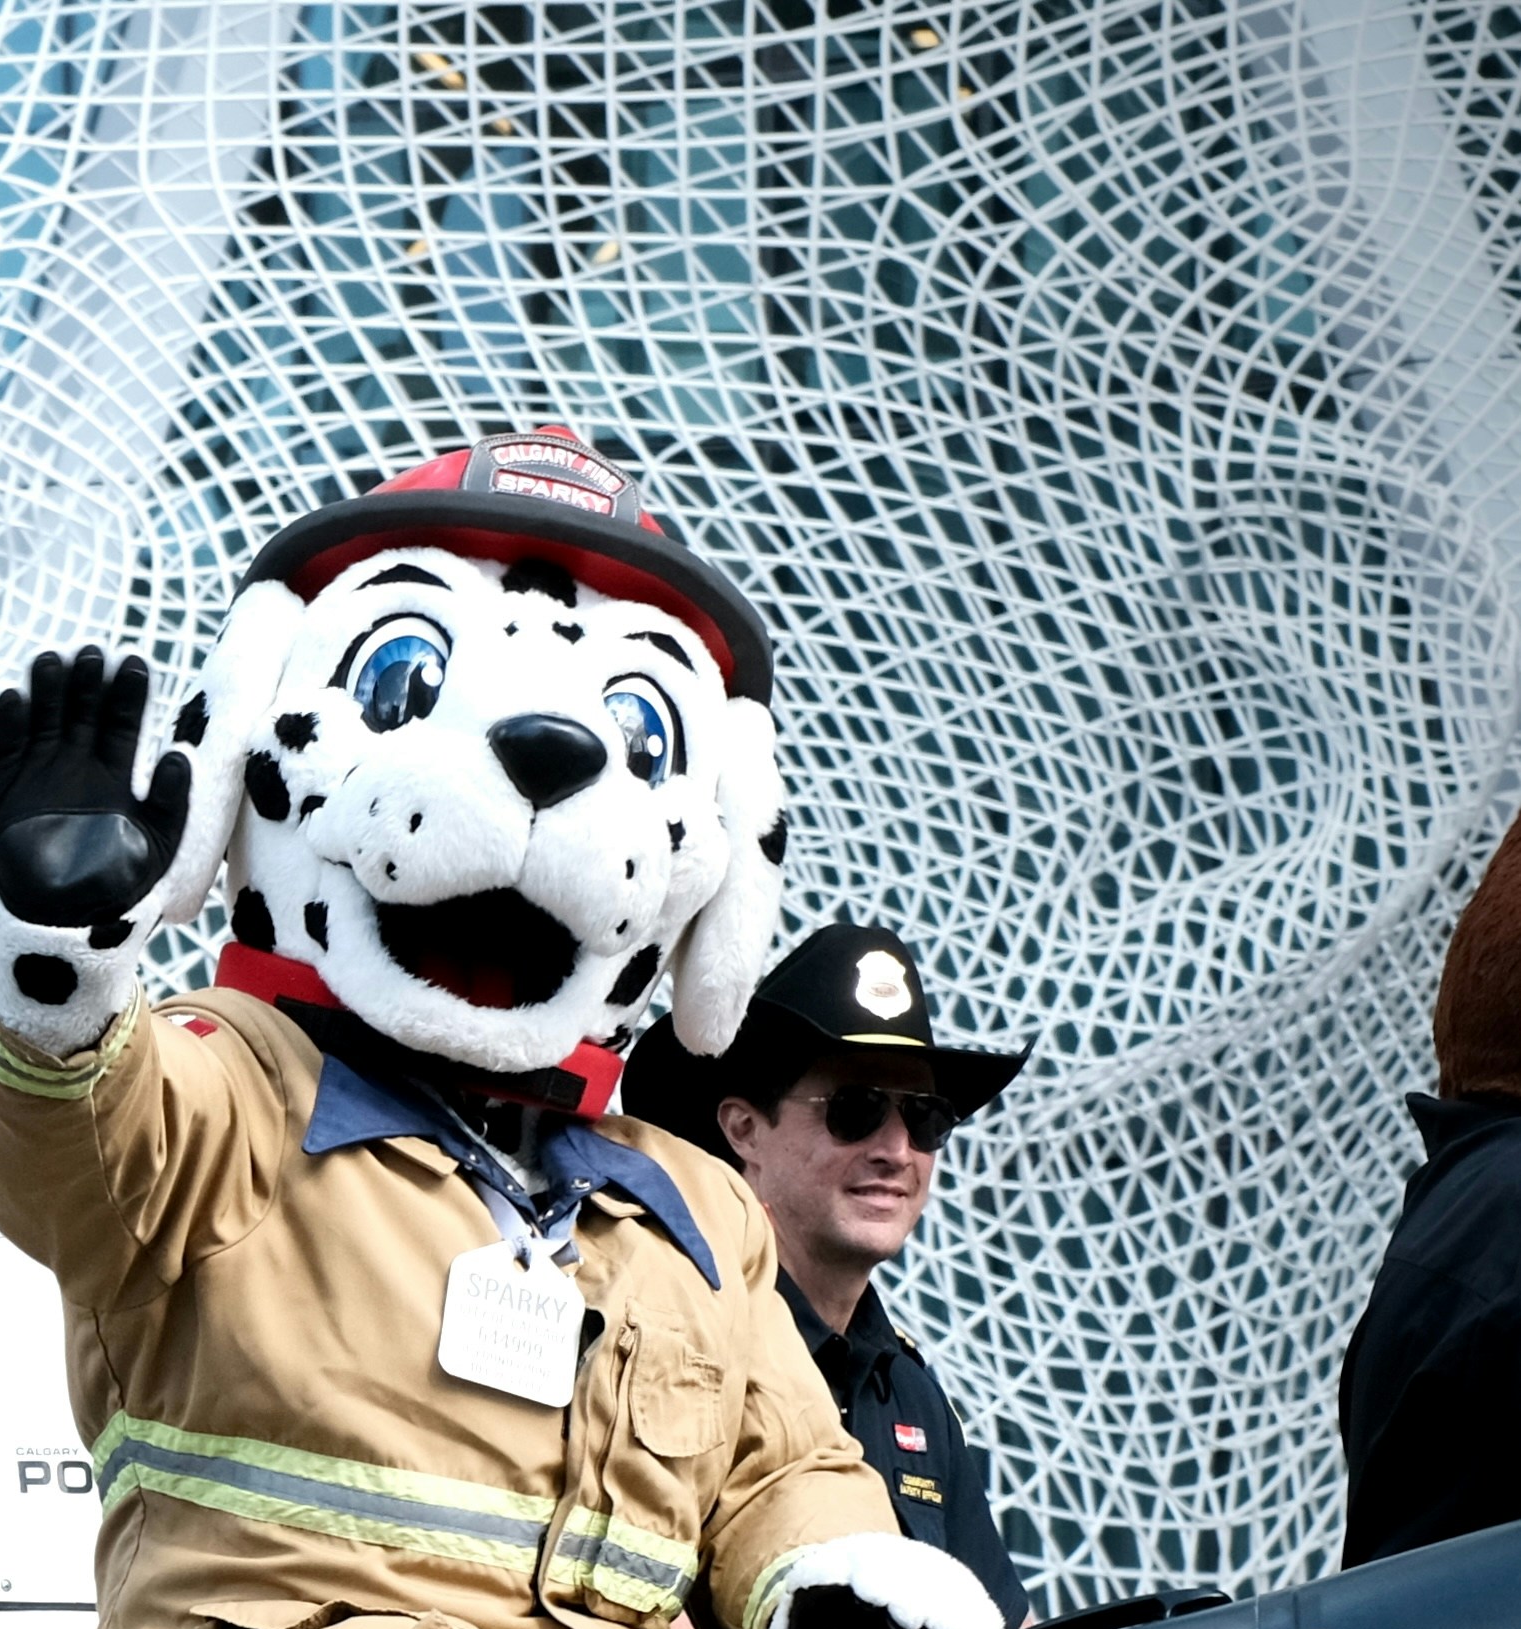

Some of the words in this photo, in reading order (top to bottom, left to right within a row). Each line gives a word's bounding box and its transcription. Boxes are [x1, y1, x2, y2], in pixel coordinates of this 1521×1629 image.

[493, 444, 576, 471] CALGARY
[582, 461, 620, 490] FIRE
[495, 473, 612, 514] SPARKY
[466, 1272, 568, 1324] SPARKY
[15, 1446, 80, 1457] CALGARY
